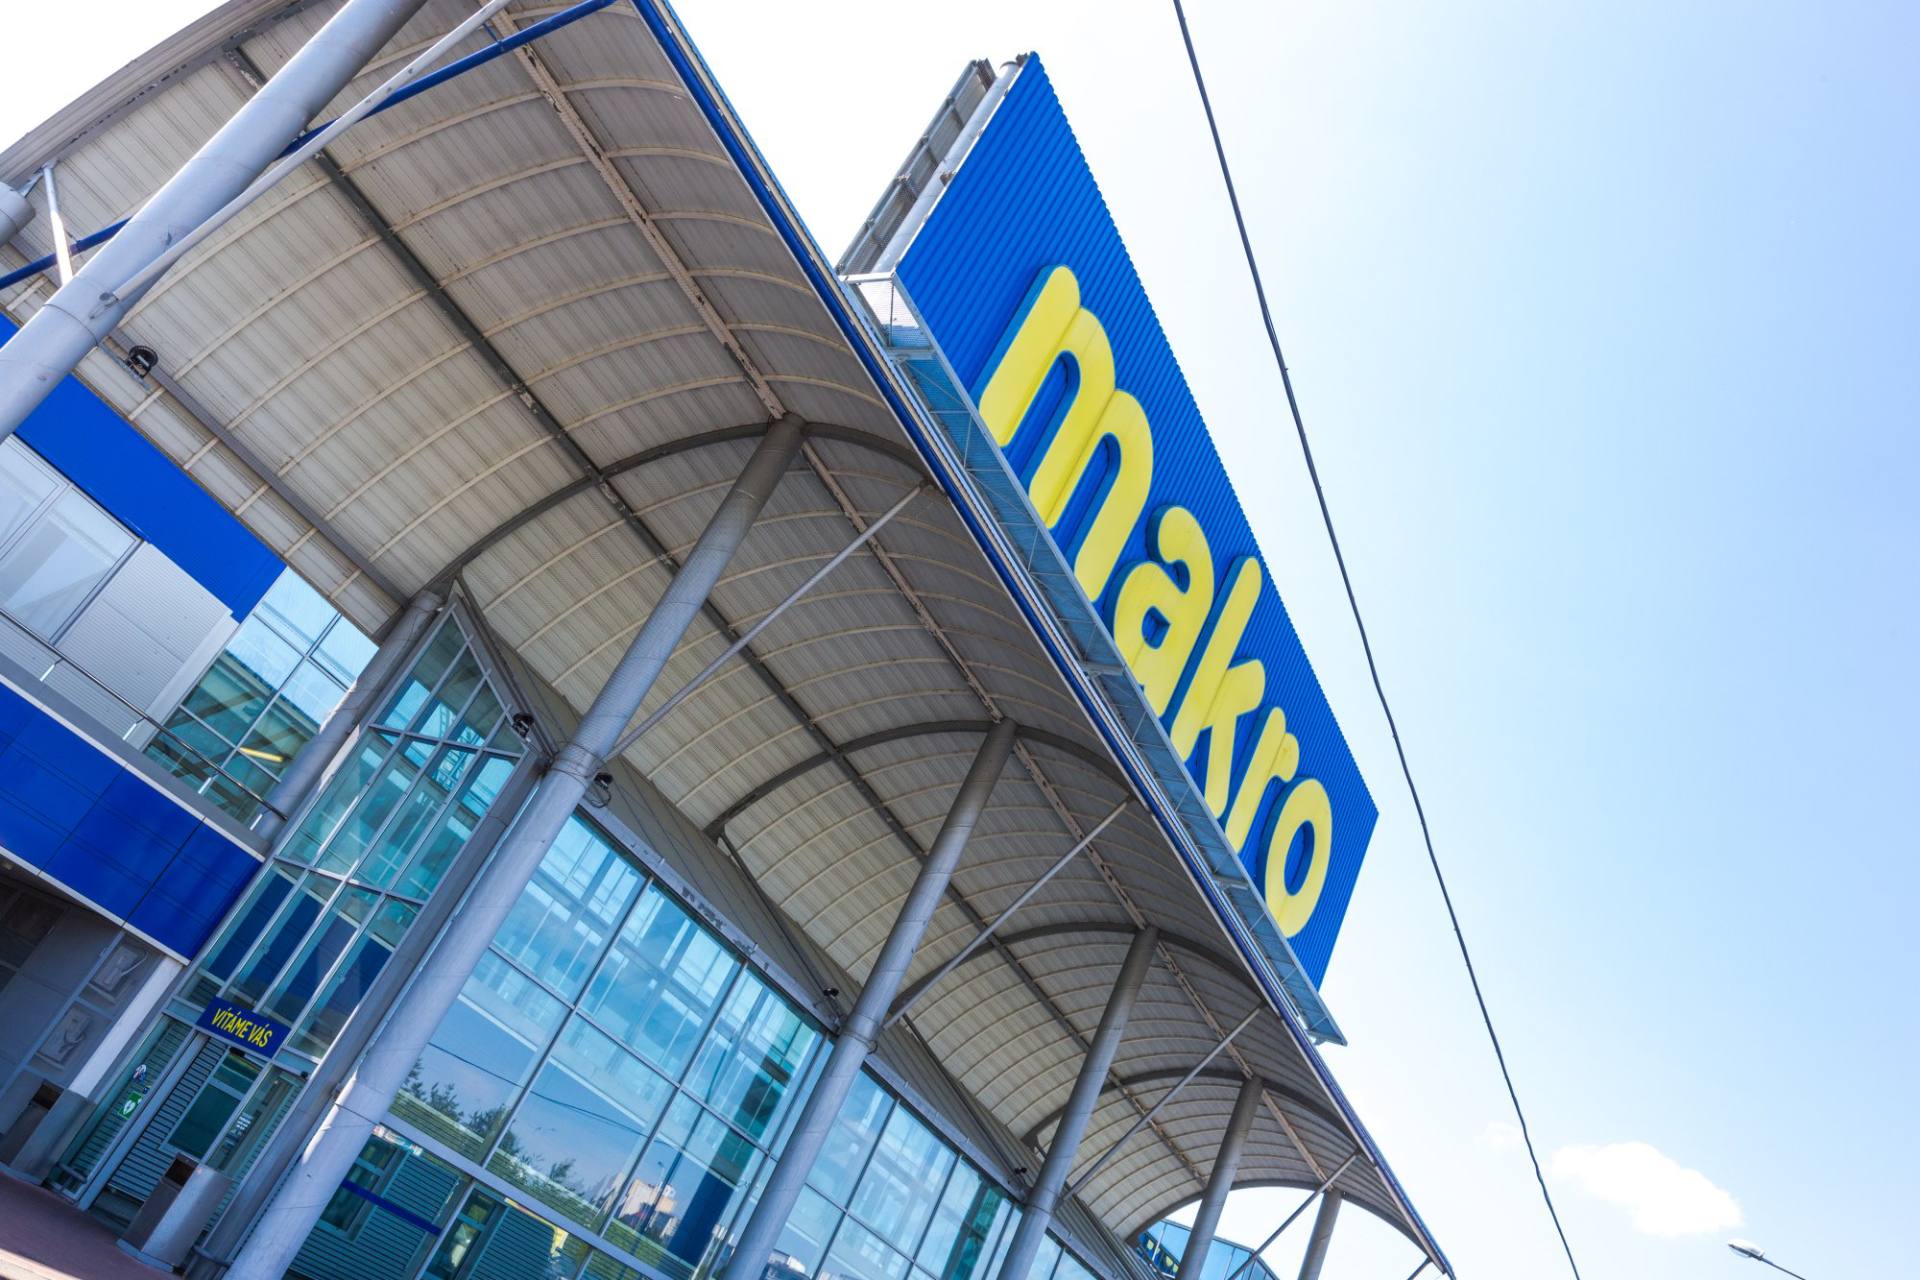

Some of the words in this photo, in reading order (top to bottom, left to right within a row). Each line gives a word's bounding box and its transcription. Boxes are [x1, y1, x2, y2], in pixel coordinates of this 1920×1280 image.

[978, 264, 1333, 939] makro
[211, 1007, 253, 1038] VÍTÁME
[247, 1023, 273, 1048] VÁS
